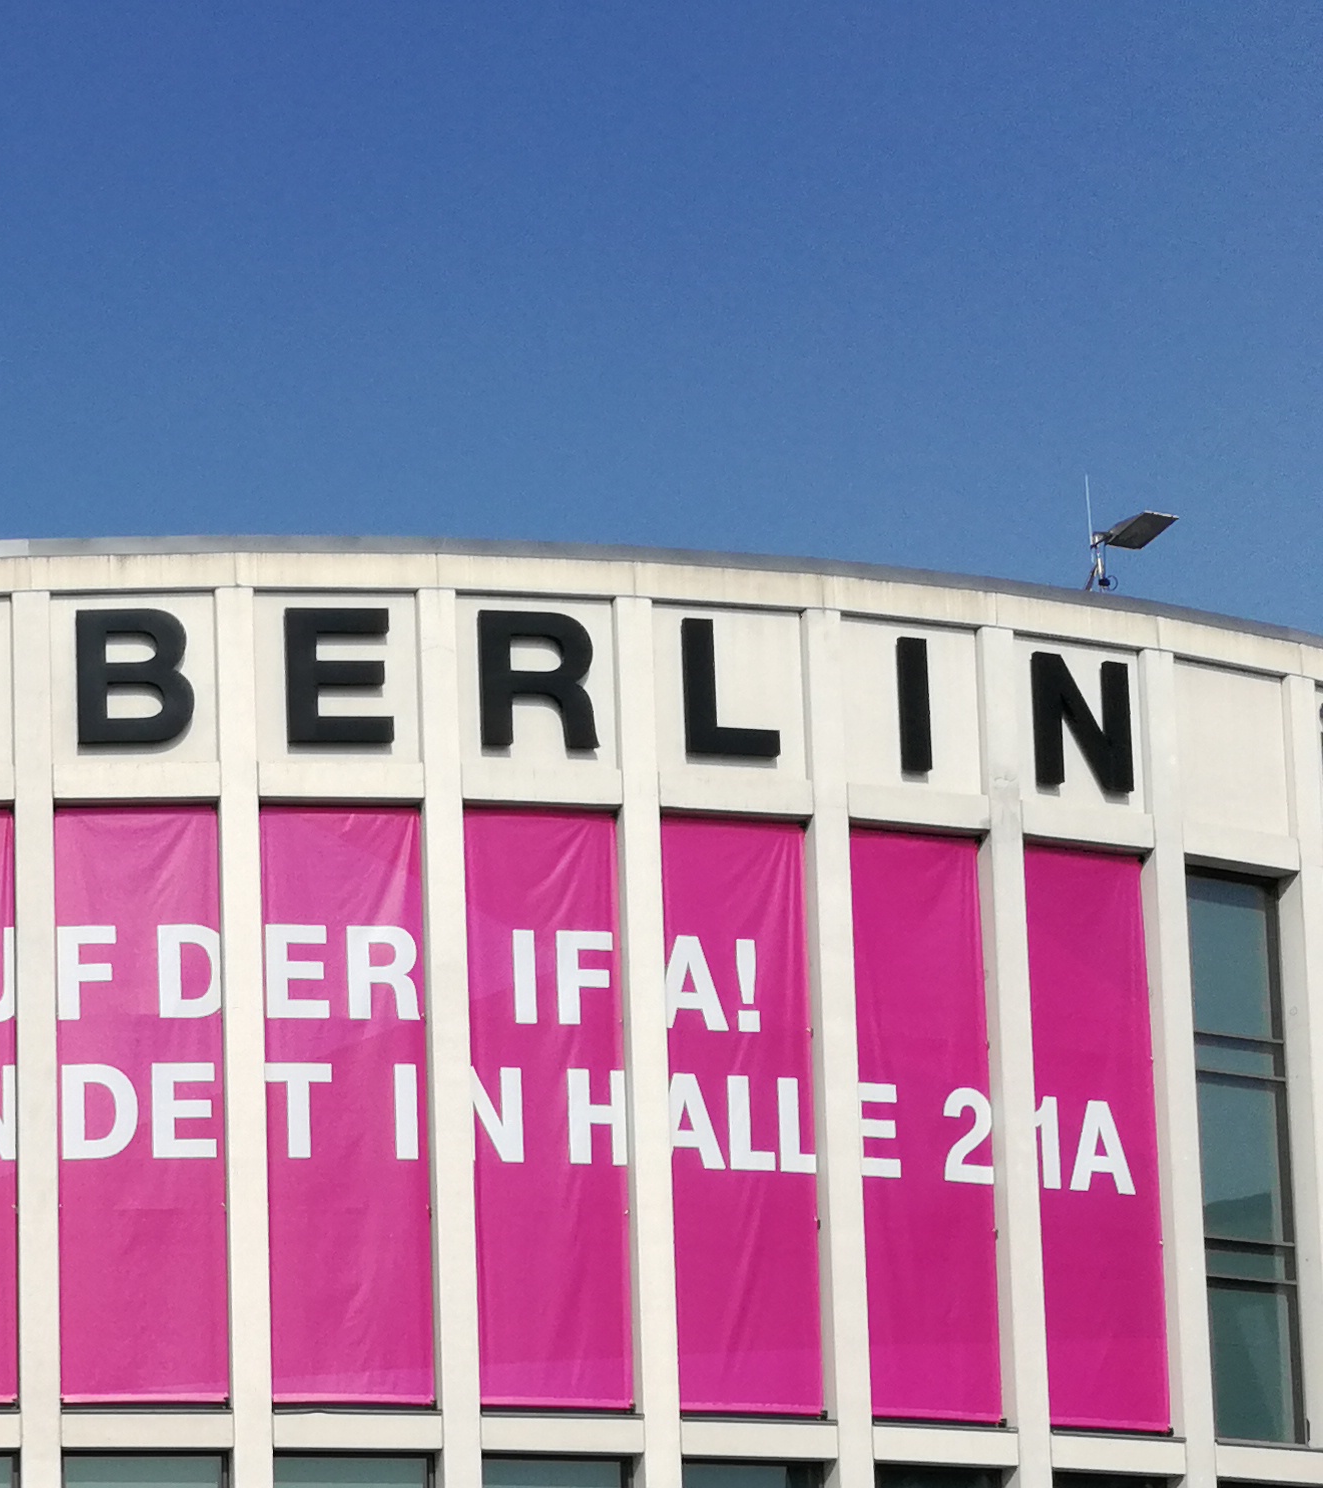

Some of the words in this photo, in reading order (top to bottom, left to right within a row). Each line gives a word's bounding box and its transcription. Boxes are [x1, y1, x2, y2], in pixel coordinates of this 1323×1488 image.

[75, 607, 1135, 794] BERLIN
[158, 923, 421, 1020] DER
[512, 929, 761, 1033] IFA!
[392, 1062, 525, 1164] IN
[566, 1067, 902, 1180] HALLE
[943, 1086, 1136, 1196] 21A
